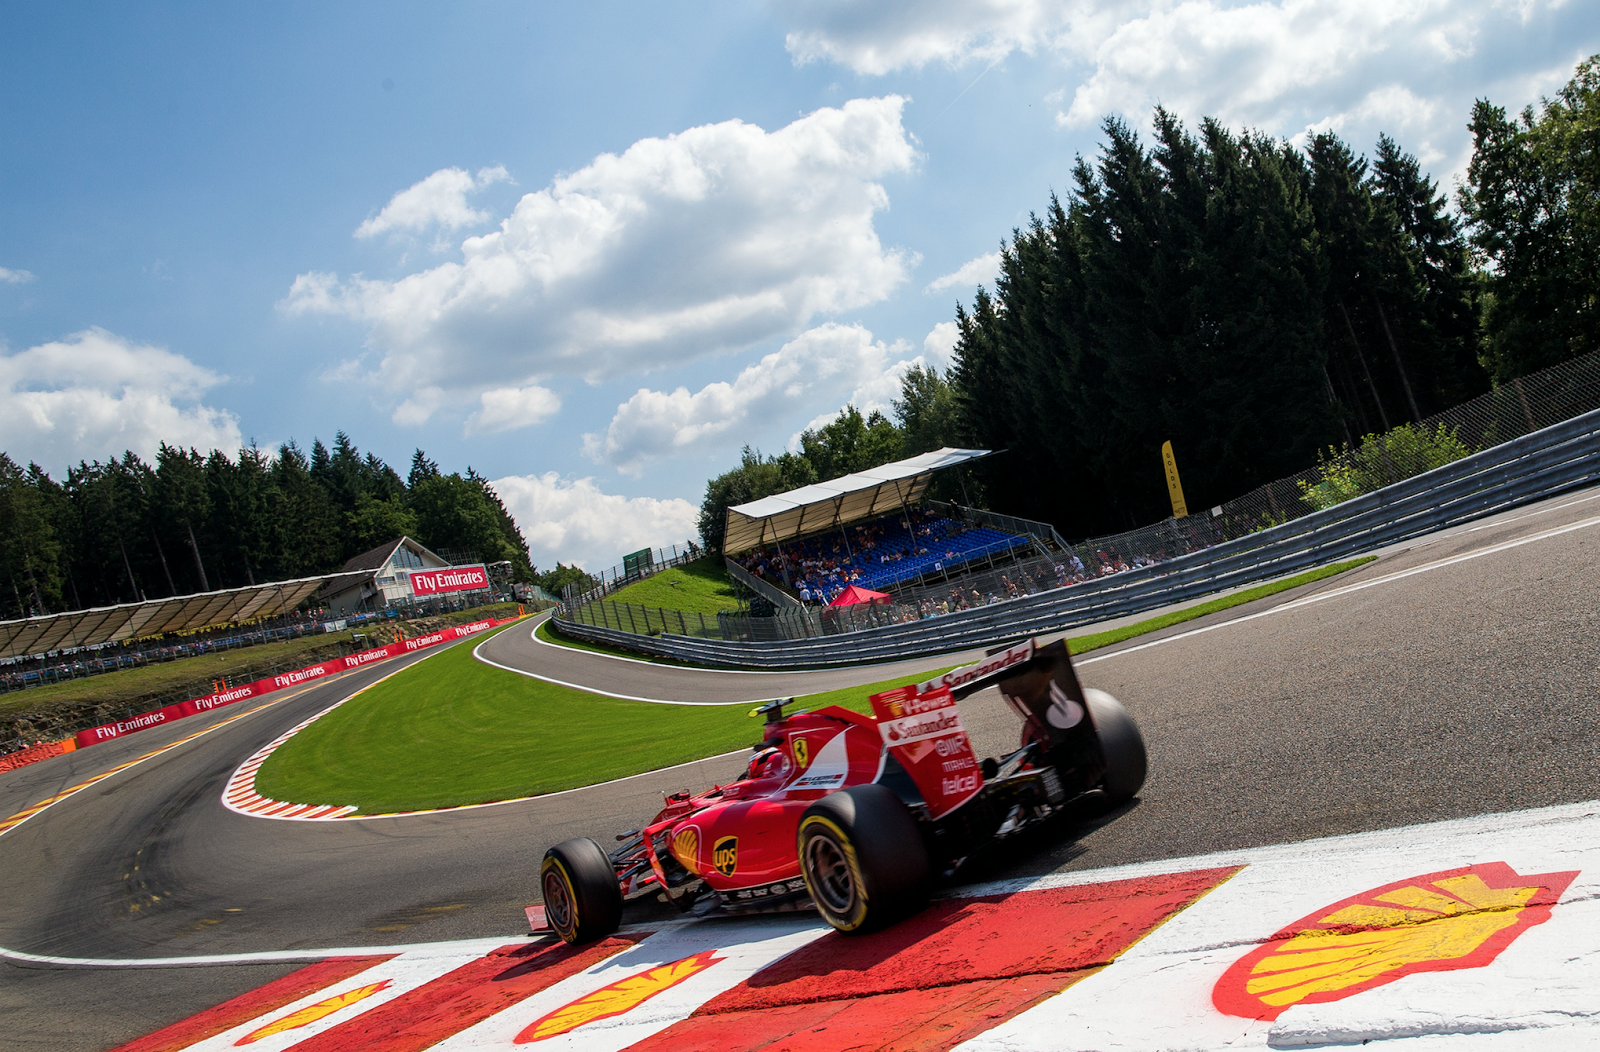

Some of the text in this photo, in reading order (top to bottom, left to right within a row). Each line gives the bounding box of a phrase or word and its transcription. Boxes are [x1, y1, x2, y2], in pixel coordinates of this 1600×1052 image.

[414, 571, 483, 591] Fly Emirates
[455, 622, 489, 636] Fly Emirates
[406, 634, 442, 649] Fly Emirates
[345, 649, 388, 666] Fly Emirates
[274, 665, 325, 687] Fly Emirates
[194, 686, 252, 710] Fly Emirates
[95, 711, 165, 739] Fly Emirates
[898, 711, 960, 739] Santander
[714, 847, 736, 873] ups
